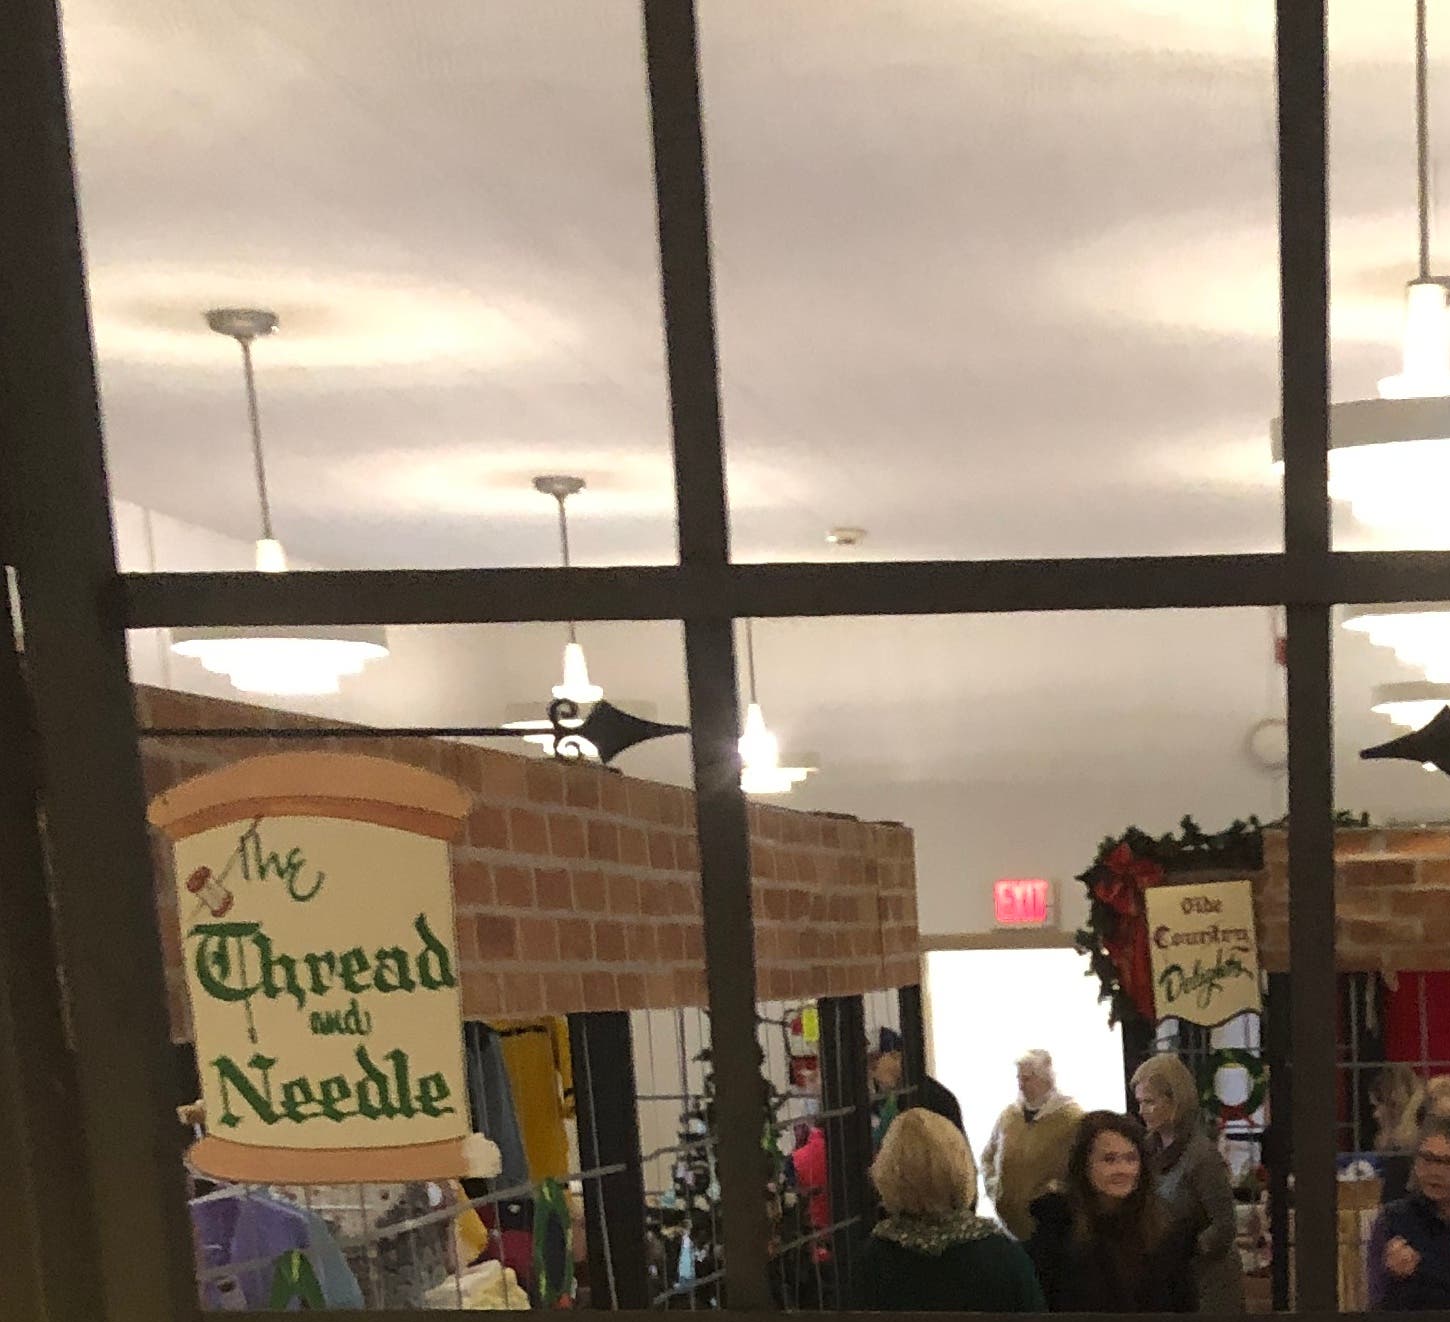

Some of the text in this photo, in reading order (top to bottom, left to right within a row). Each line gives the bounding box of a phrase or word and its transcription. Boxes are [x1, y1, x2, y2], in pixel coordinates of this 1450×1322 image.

[237, 820, 325, 902] The
[996, 880, 1046, 917] EXIT
[188, 912, 456, 1010] Thread
[309, 999, 373, 1036] and
[211, 1044, 455, 1127] Needle
